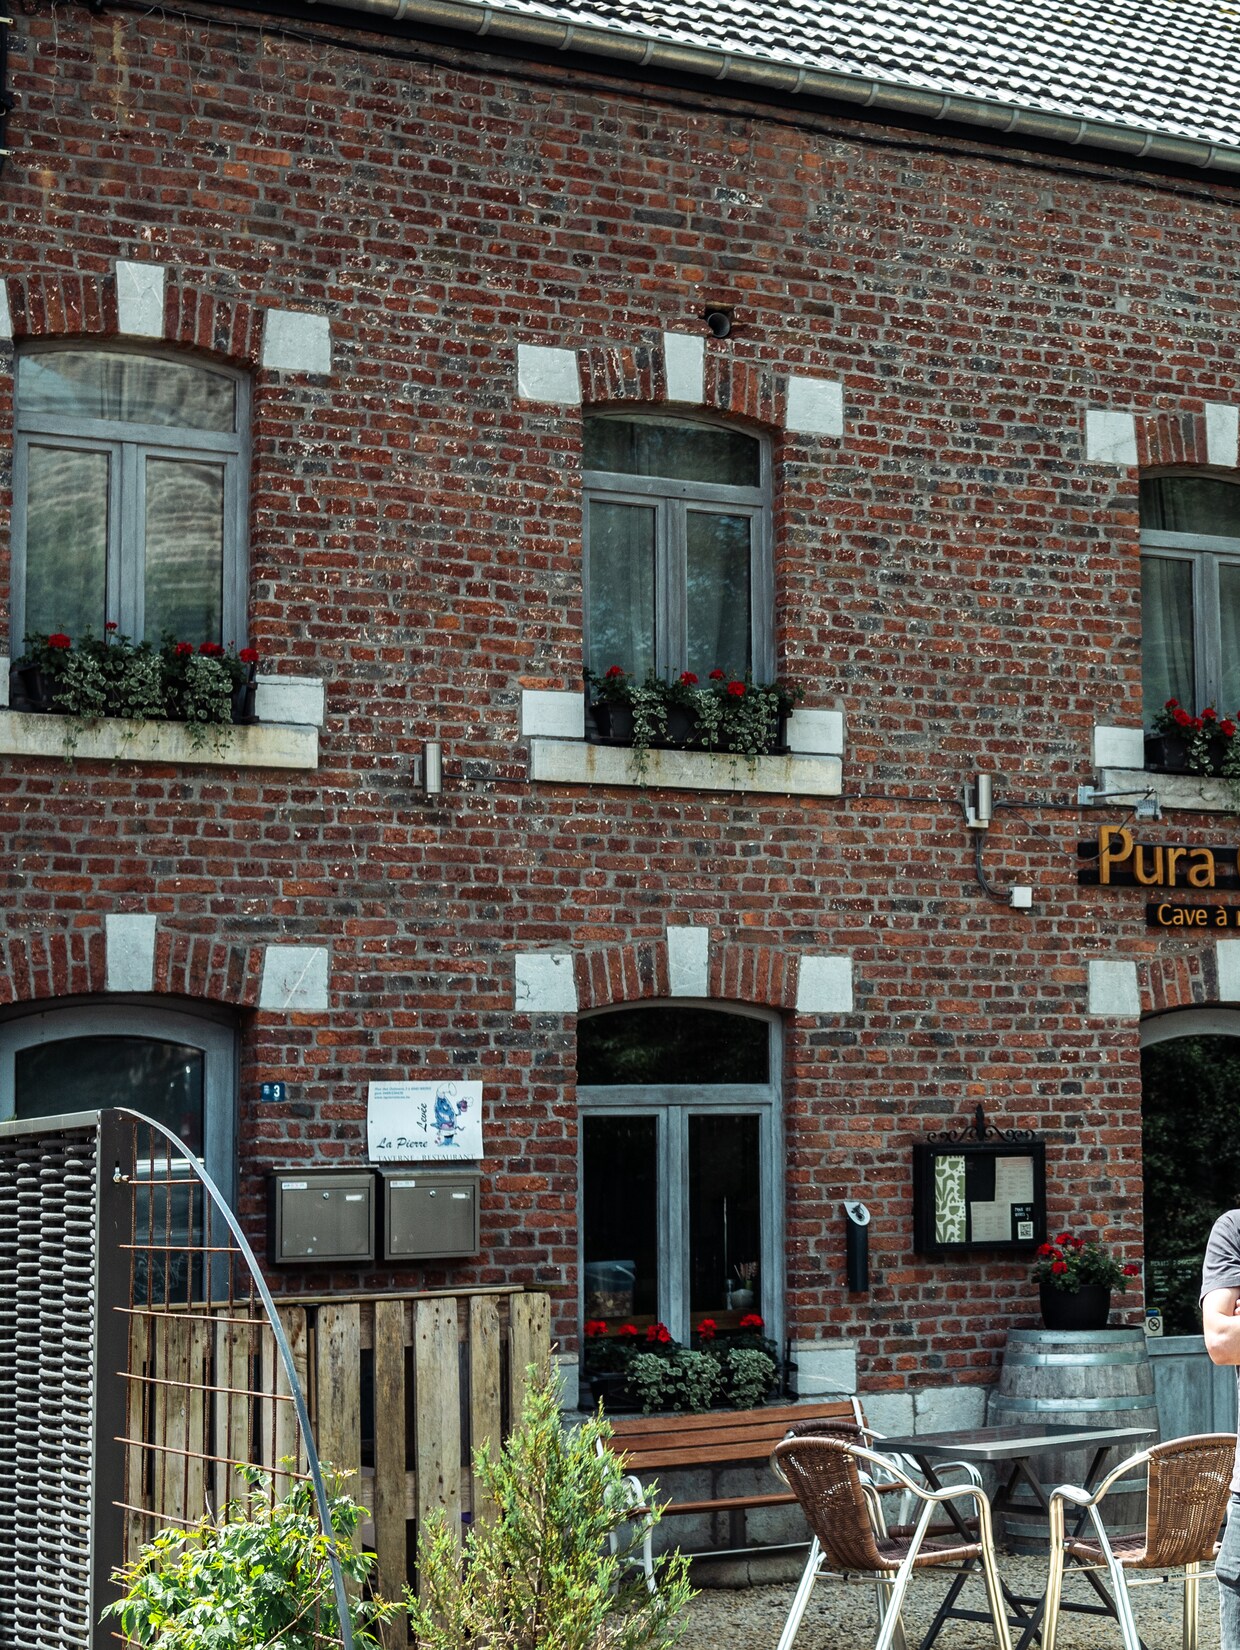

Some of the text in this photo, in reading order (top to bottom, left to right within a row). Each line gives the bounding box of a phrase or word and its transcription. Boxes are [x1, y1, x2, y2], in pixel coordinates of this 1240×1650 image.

[1099, 825, 1215, 887] Pura
[1157, 903, 1208, 926] Cave
[1215, 904, 1228, 926] à
[273, 1084, 280, 1097] 3
[376, 1137, 428, 1150] La Pierre
